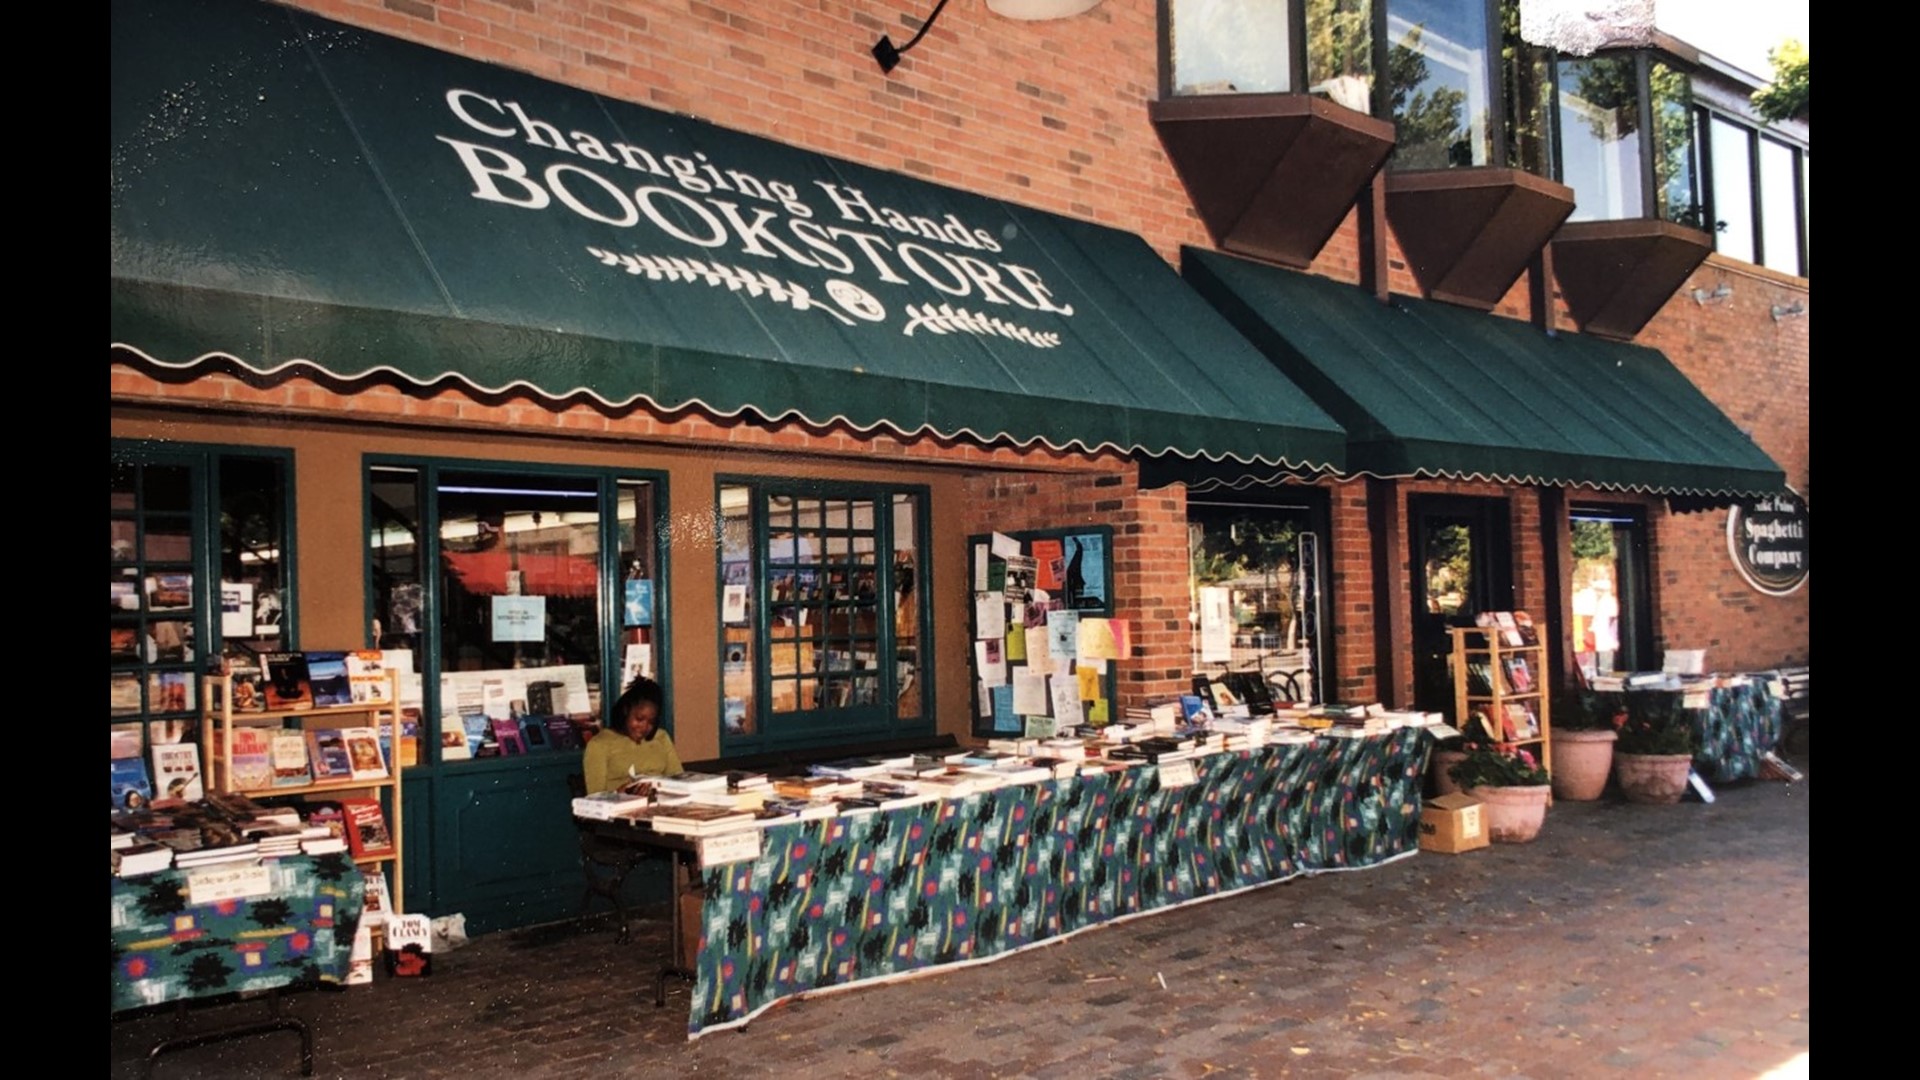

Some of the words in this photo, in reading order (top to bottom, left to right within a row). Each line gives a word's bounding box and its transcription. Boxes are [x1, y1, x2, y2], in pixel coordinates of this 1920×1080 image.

[446, 89, 813, 217] Changing
[813, 180, 1002, 253] Hands
[435, 134, 1074, 316] BOOKSTORE
[1745, 517, 1803, 543] Spaghetti
[1748, 544, 1801, 569] Company
[392, 928, 428, 938] CLANCY
[402, 919, 421, 929] TOM
